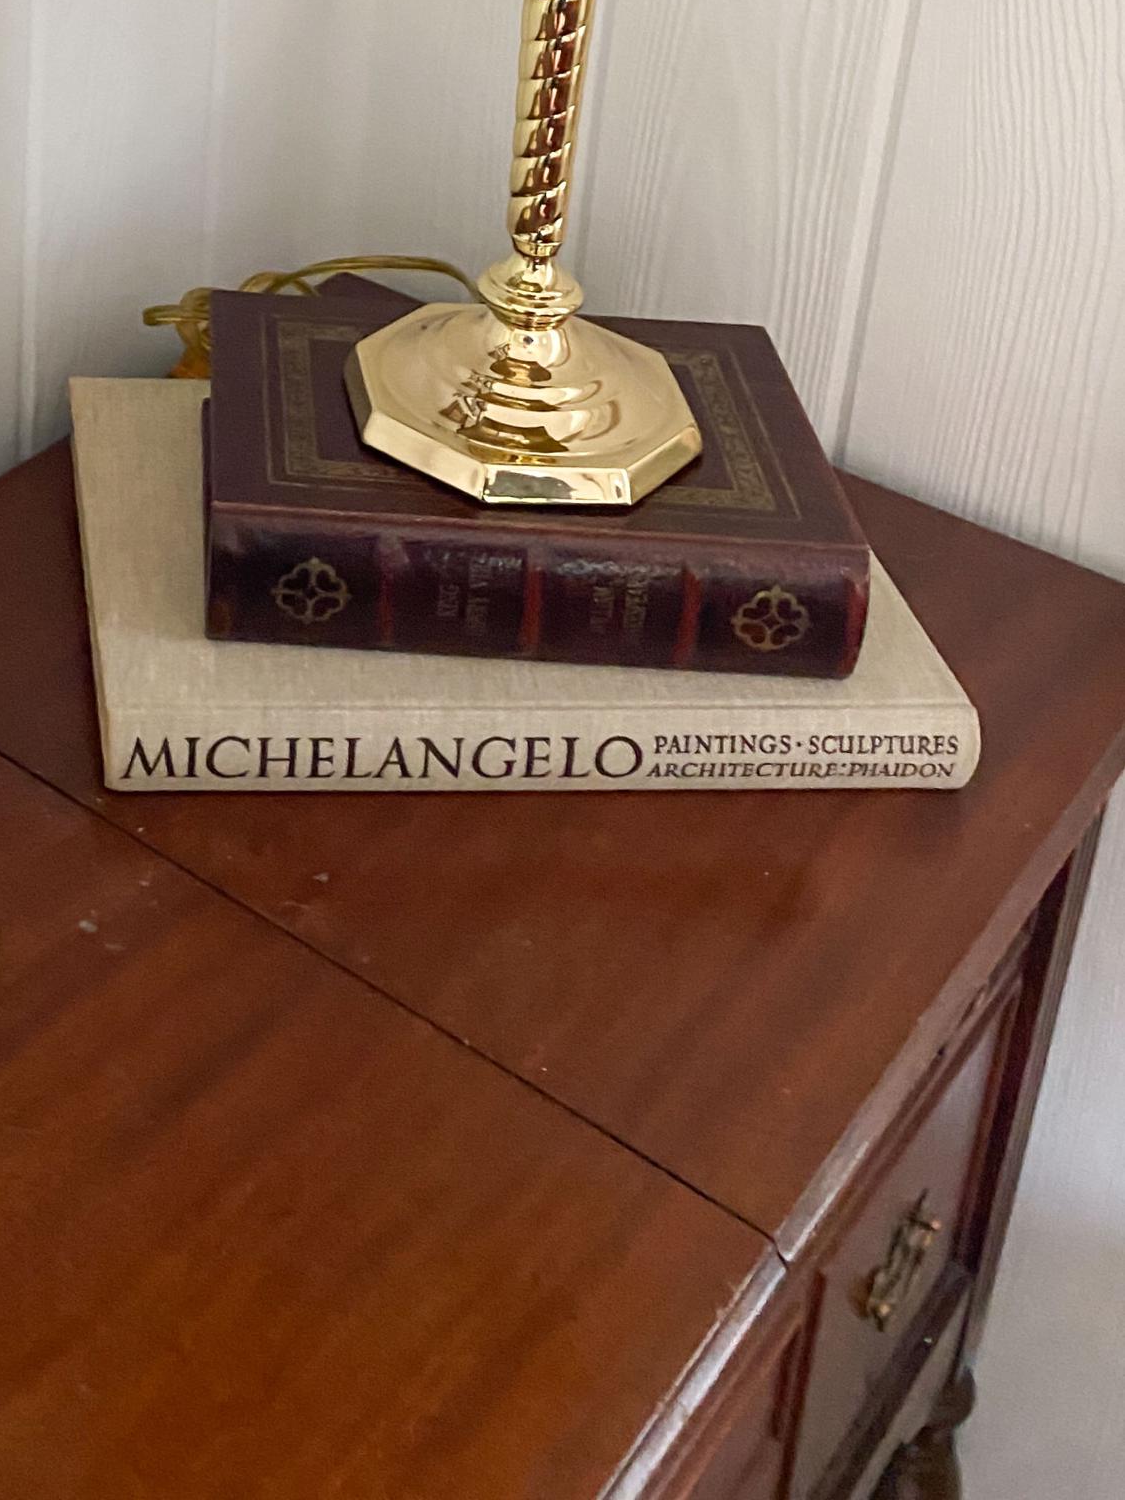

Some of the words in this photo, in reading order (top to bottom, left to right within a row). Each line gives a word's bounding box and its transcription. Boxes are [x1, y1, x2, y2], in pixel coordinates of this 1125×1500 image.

[119, 735, 644, 780] MICHELANGELO
[653, 734, 792, 755] PAINTINGS
[808, 734, 960, 756] SCULPTURES
